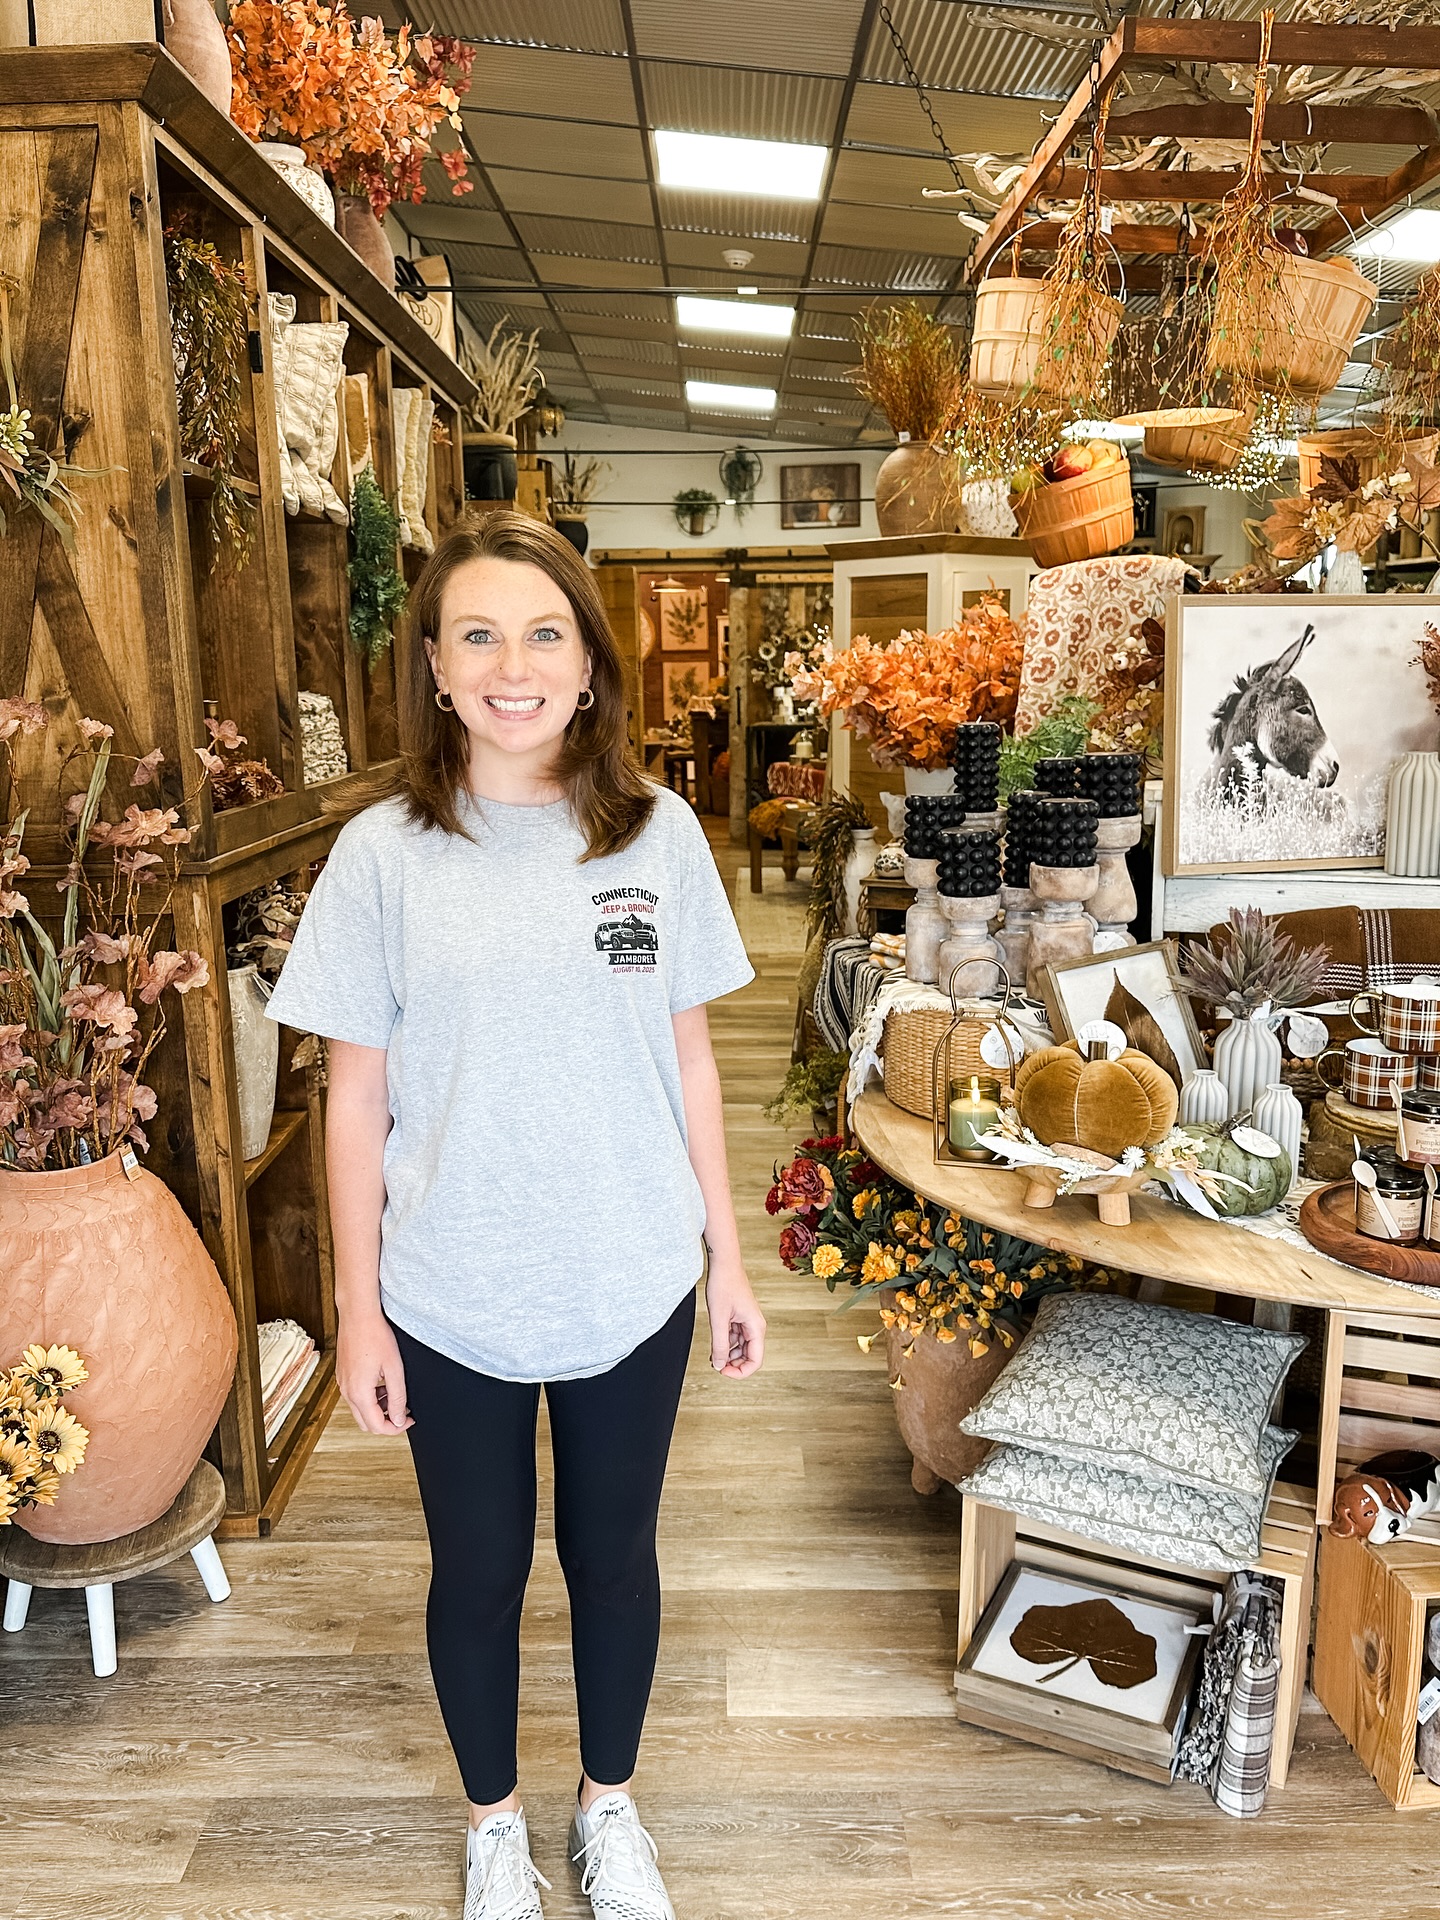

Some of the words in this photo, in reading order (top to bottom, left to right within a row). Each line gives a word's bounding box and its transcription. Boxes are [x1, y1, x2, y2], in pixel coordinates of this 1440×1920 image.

[591, 888, 660, 906] CONNECTICUT
[601, 904, 621, 914] JEEP
[627, 904, 655, 914] BRONCO
[613, 955, 654, 964] JAMBOREE
[612, 966, 635, 974] AUGUST
[641, 966, 655, 974] 2025
